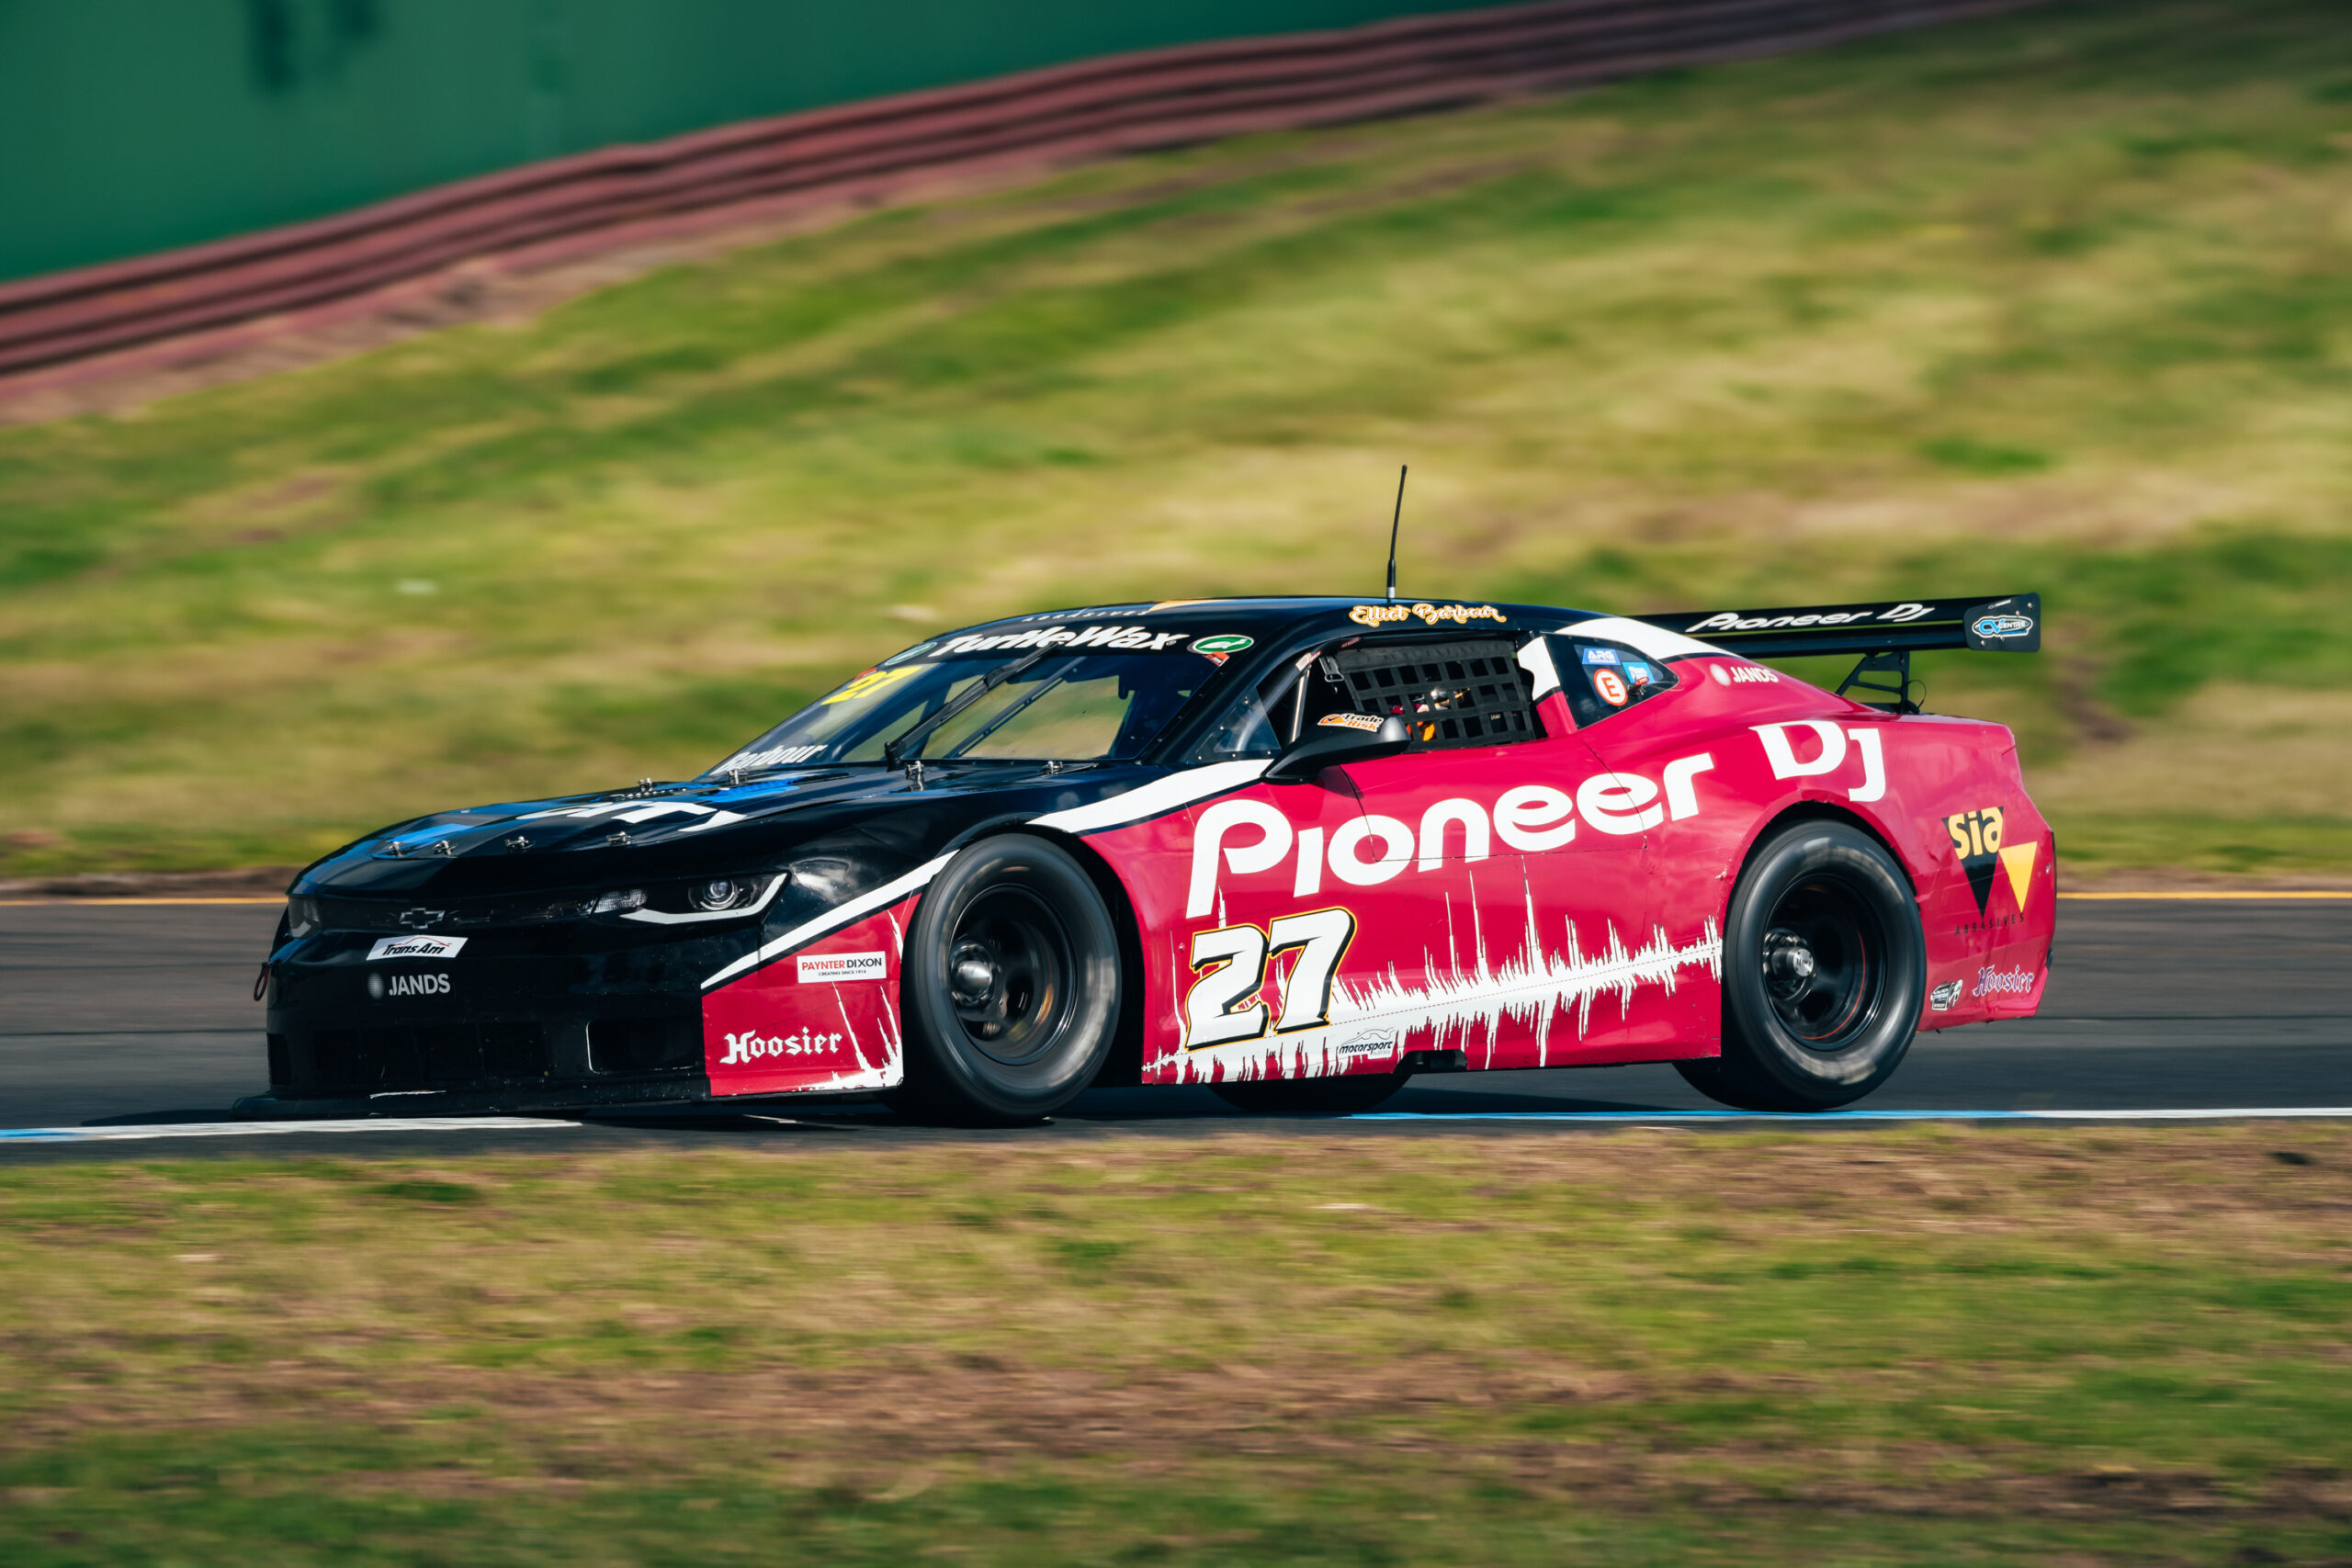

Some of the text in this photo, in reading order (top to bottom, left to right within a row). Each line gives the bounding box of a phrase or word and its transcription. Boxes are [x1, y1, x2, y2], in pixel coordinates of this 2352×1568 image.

[1349, 603, 1507, 627] Elliot Barbour
[1685, 611, 1873, 633] Pioneer
[820, 666, 922, 705] 27
[1732, 666, 1780, 683] JANDS
[1601, 677, 1621, 697] E
[1342, 714, 1383, 724] Trade
[1347, 720, 1376, 731] Risk
[1185, 751, 1714, 919] Pioneer
[1948, 807, 2004, 860] sia
[1954, 912, 2025, 936] ABRASIVES
[382, 942, 446, 956] Trans Am
[801, 957, 882, 971] PAYNTER DIXON
[389, 973, 451, 996] JANDS
[1183, 906, 1358, 1053] 27
[1973, 964, 2035, 998] Hoosier
[719, 1026, 842, 1065] Hoosier
[1339, 1041, 1394, 1055] motorsport
